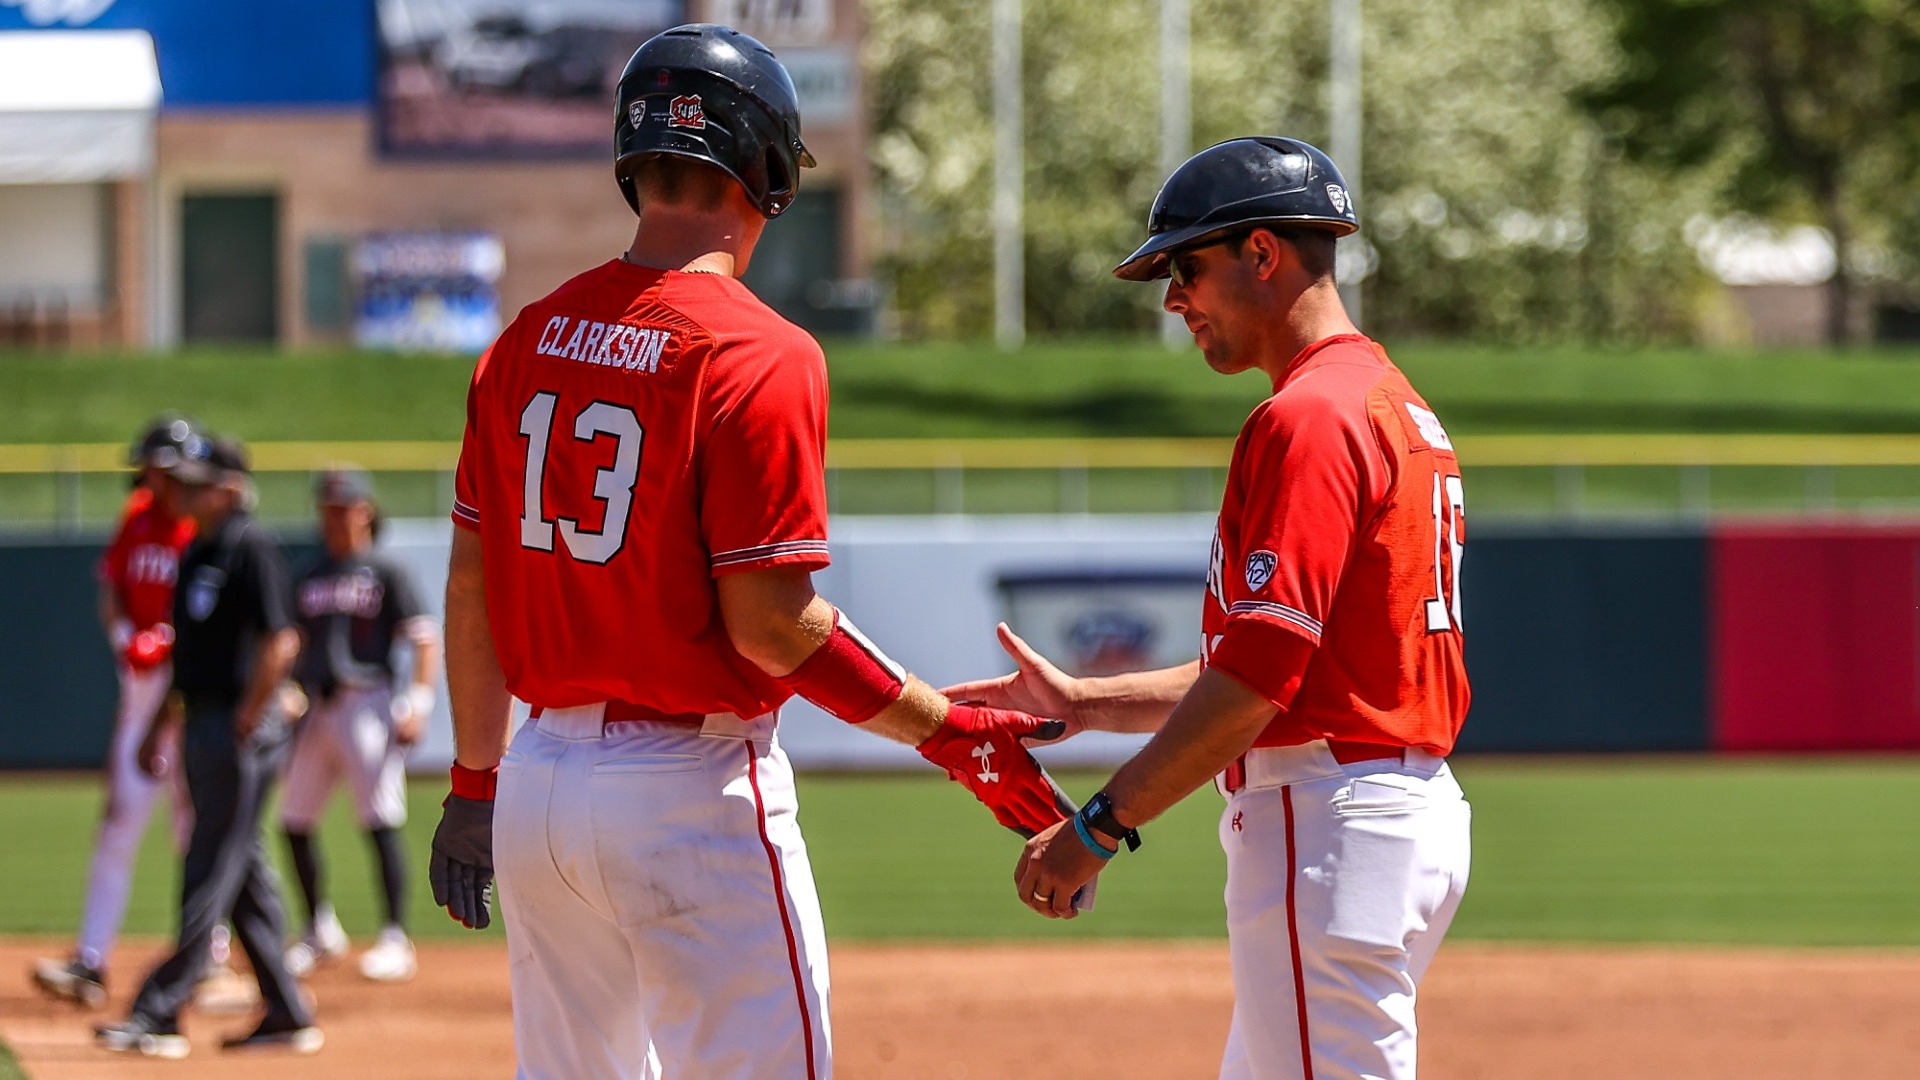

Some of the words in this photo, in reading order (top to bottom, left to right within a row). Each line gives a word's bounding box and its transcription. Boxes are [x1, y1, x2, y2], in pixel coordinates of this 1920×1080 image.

[536, 315, 670, 374] CLARKSON
[518, 390, 645, 566] 13
[1246, 552, 1276, 578] PAC
[1248, 568, 1264, 585] 12
